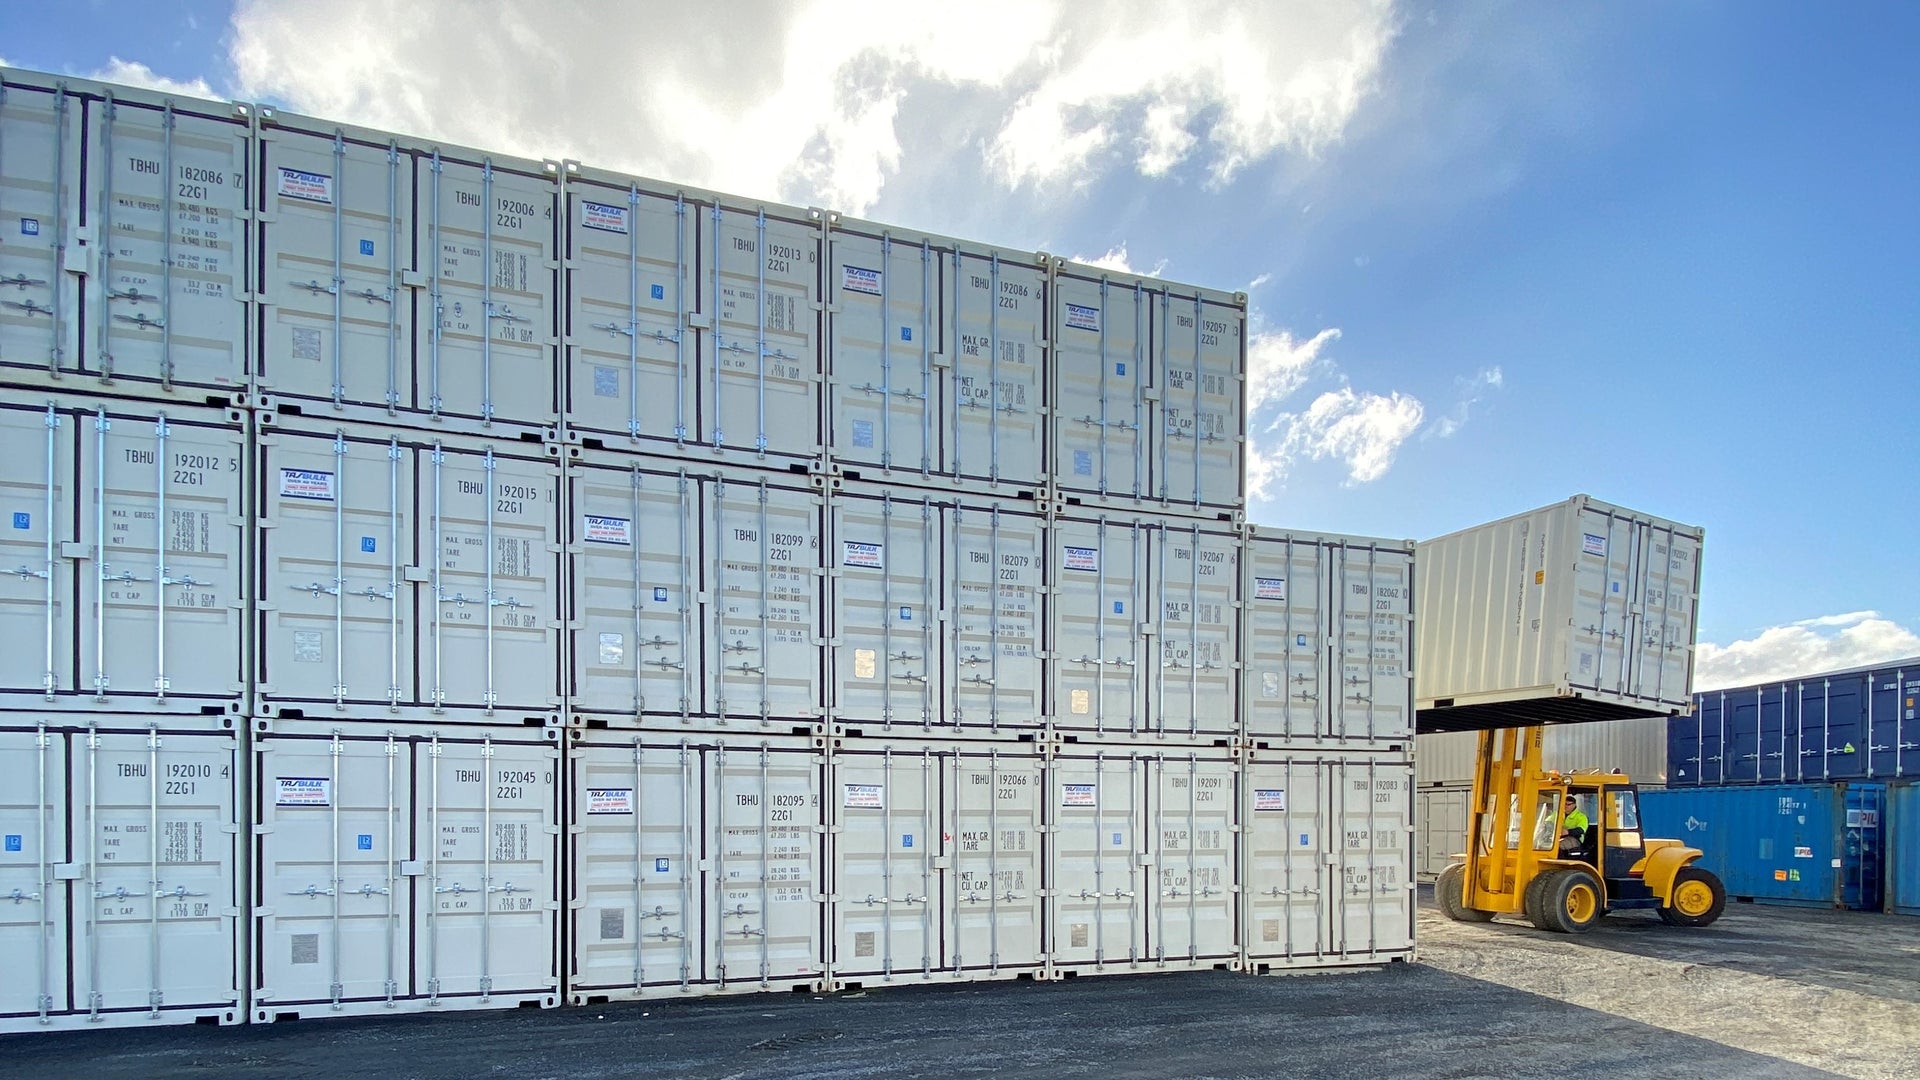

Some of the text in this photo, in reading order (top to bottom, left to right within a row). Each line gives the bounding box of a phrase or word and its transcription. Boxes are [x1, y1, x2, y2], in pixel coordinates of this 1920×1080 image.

[129, 158, 242, 187] TBHU 182086 7
[179, 184, 207, 200] 22G1
[456, 191, 551, 219] TBHU 192006 4
[497, 214, 522, 229] 22G1
[733, 238, 815, 263] TBHU 192013 0
[768, 259, 789, 273] 22G1
[971, 276, 1041, 299] TBHU 192086 6
[1000, 297, 1017, 309] 22G1
[1177, 316, 1238, 336] TBHU 192057 3
[1202, 334, 1217, 346] 22G1
[963, 345, 979, 356] TARE
[962, 377, 973, 387] NET
[1169, 379, 1184, 389] TARE
[1169, 409, 1179, 418] NET
[125, 450, 237, 472] TBHU 192012 5
[174, 471, 203, 485] 22G1
[458, 481, 552, 502] TBHU 192015 1
[497, 500, 522, 514] 22G1
[734, 529, 816, 547] TBHU 182099 6
[770, 549, 792, 561] 22G1
[970, 552, 989, 563] TBHU
[1001, 555, 1028, 566] 182079
[1175, 549, 1190, 560] TBHU
[1200, 552, 1224, 563] 192067
[1000, 569, 1018, 580] 22G1
[1199, 565, 1215, 575] 22G1
[1166, 611, 1180, 620] TARE
[1165, 641, 1175, 649] NET
[118, 764, 229, 778] TBHU 192010 4
[456, 770, 551, 783] TBHU 192045 0
[972, 775, 1039, 785] TBHU 192066 0
[1172, 778, 1187, 787] TBHU
[1198, 778, 1221, 788] 192091
[1354, 781, 1368, 790] TBHU
[166, 782, 195, 794] 22G1
[497, 787, 522, 799] 22G1
[999, 789, 1016, 799] 22G1
[736, 795, 817, 806] TBHU 182095 4
[1197, 792, 1213, 801] 22G1
[772, 810, 793, 821] 22G1
[963, 842, 978, 850] TARE
[1164, 840, 1178, 848] TARE
[962, 872, 973, 880] NET
[1164, 869, 1174, 877] NET
